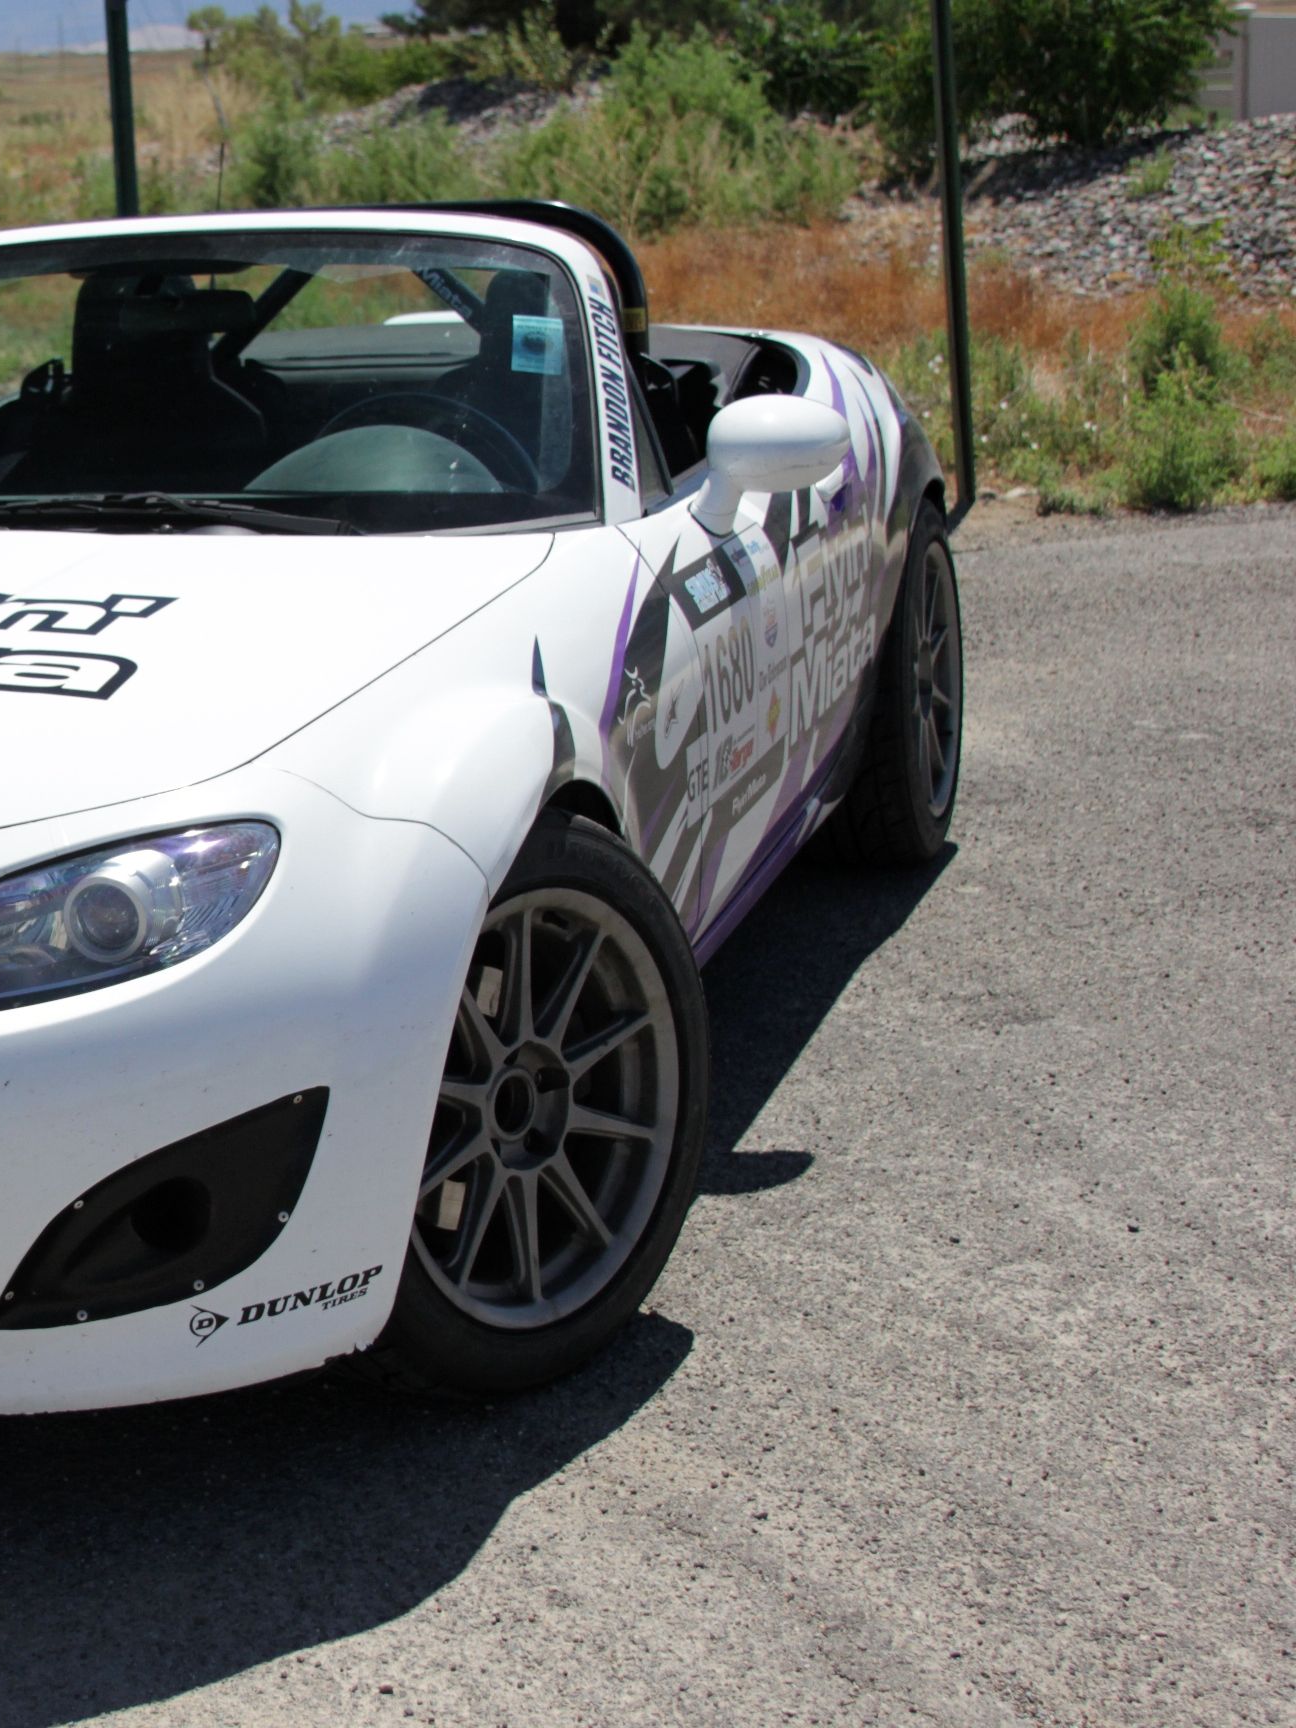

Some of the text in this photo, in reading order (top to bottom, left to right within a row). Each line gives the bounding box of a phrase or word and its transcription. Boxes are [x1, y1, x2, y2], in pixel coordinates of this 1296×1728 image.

[589, 296, 622, 368] FITCH
[600, 366, 636, 492] BRANDON
[703, 615, 756, 736] 1680
[790, 614, 877, 749] Miata
[687, 758, 709, 803] GTE
[237, 1264, 383, 1326] DUNLOP
[321, 1288, 368, 1311] TIRES
